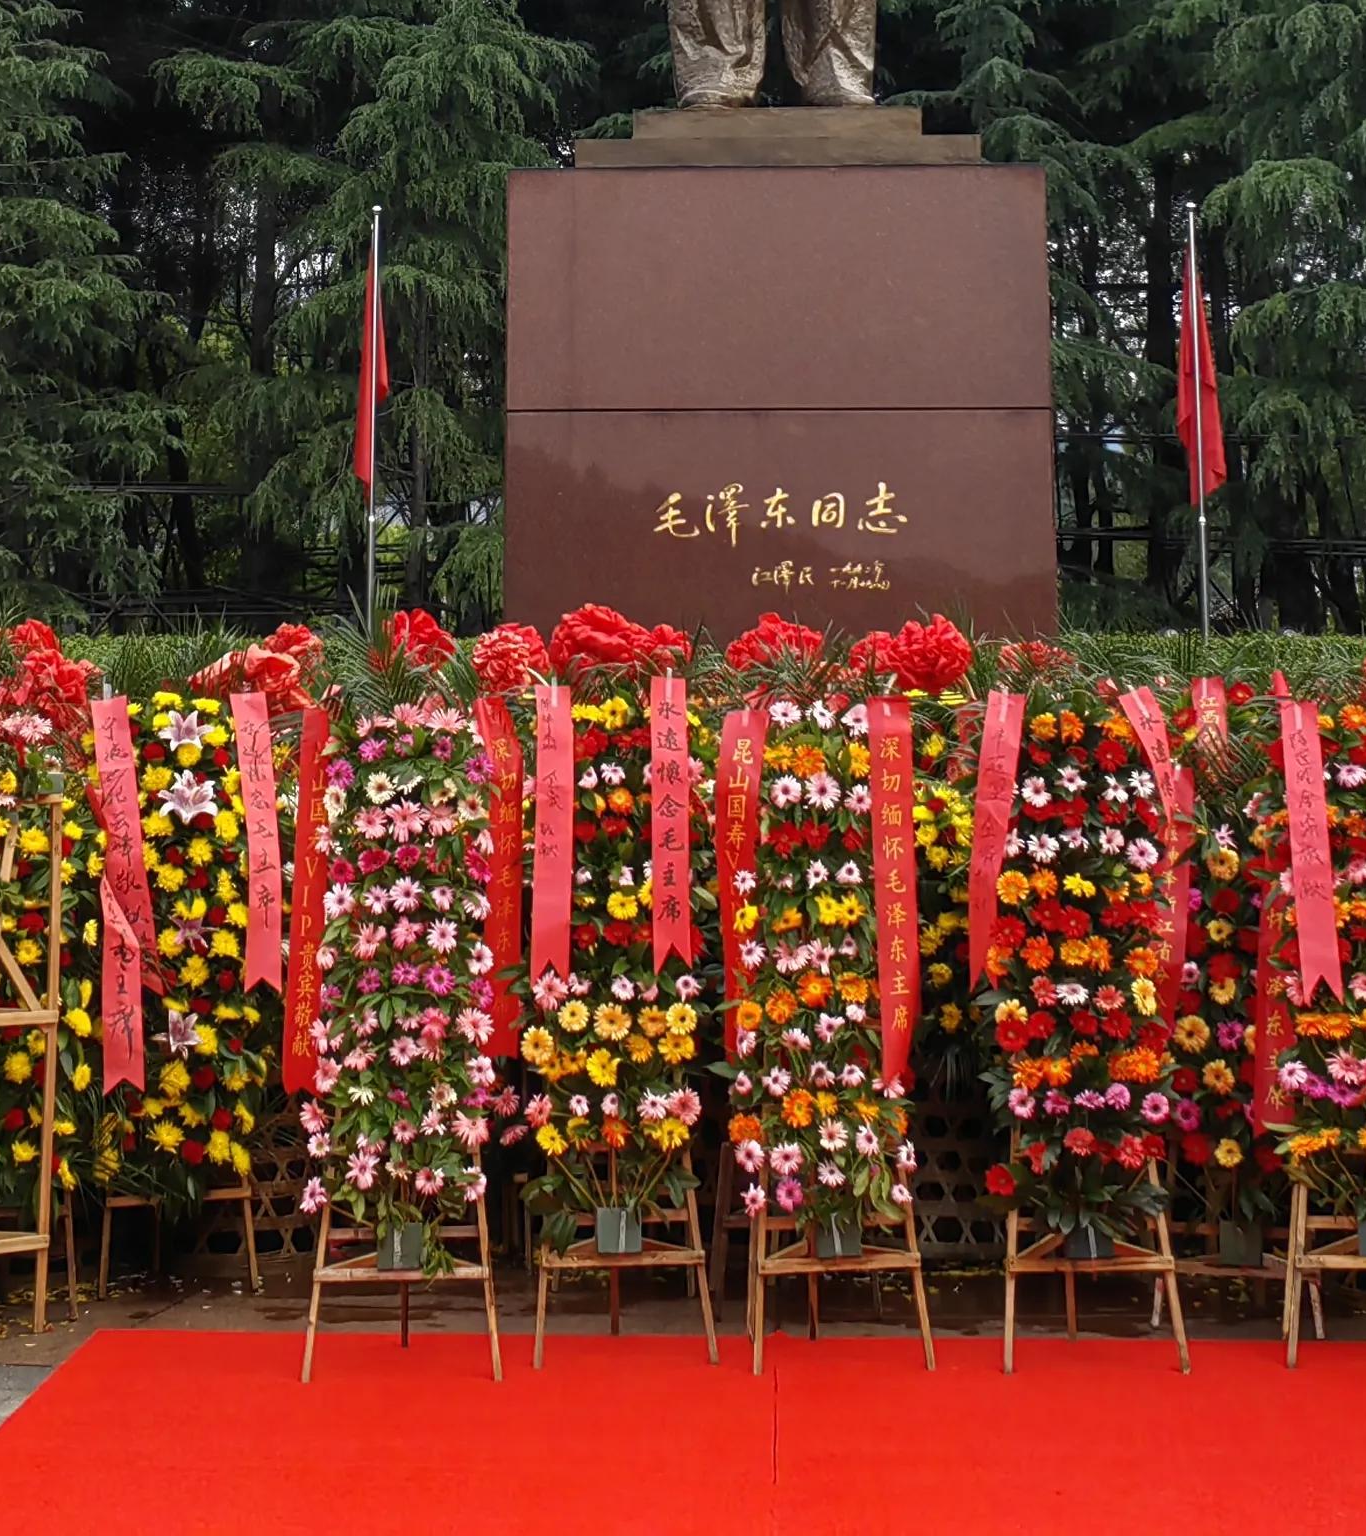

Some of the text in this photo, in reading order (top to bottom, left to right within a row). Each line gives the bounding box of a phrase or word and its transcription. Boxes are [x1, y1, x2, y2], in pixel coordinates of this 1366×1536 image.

[656, 702, 685, 925] 永遠懷念毛主席
[879, 736, 911, 1032] 深切缅怀毛泽东主席
